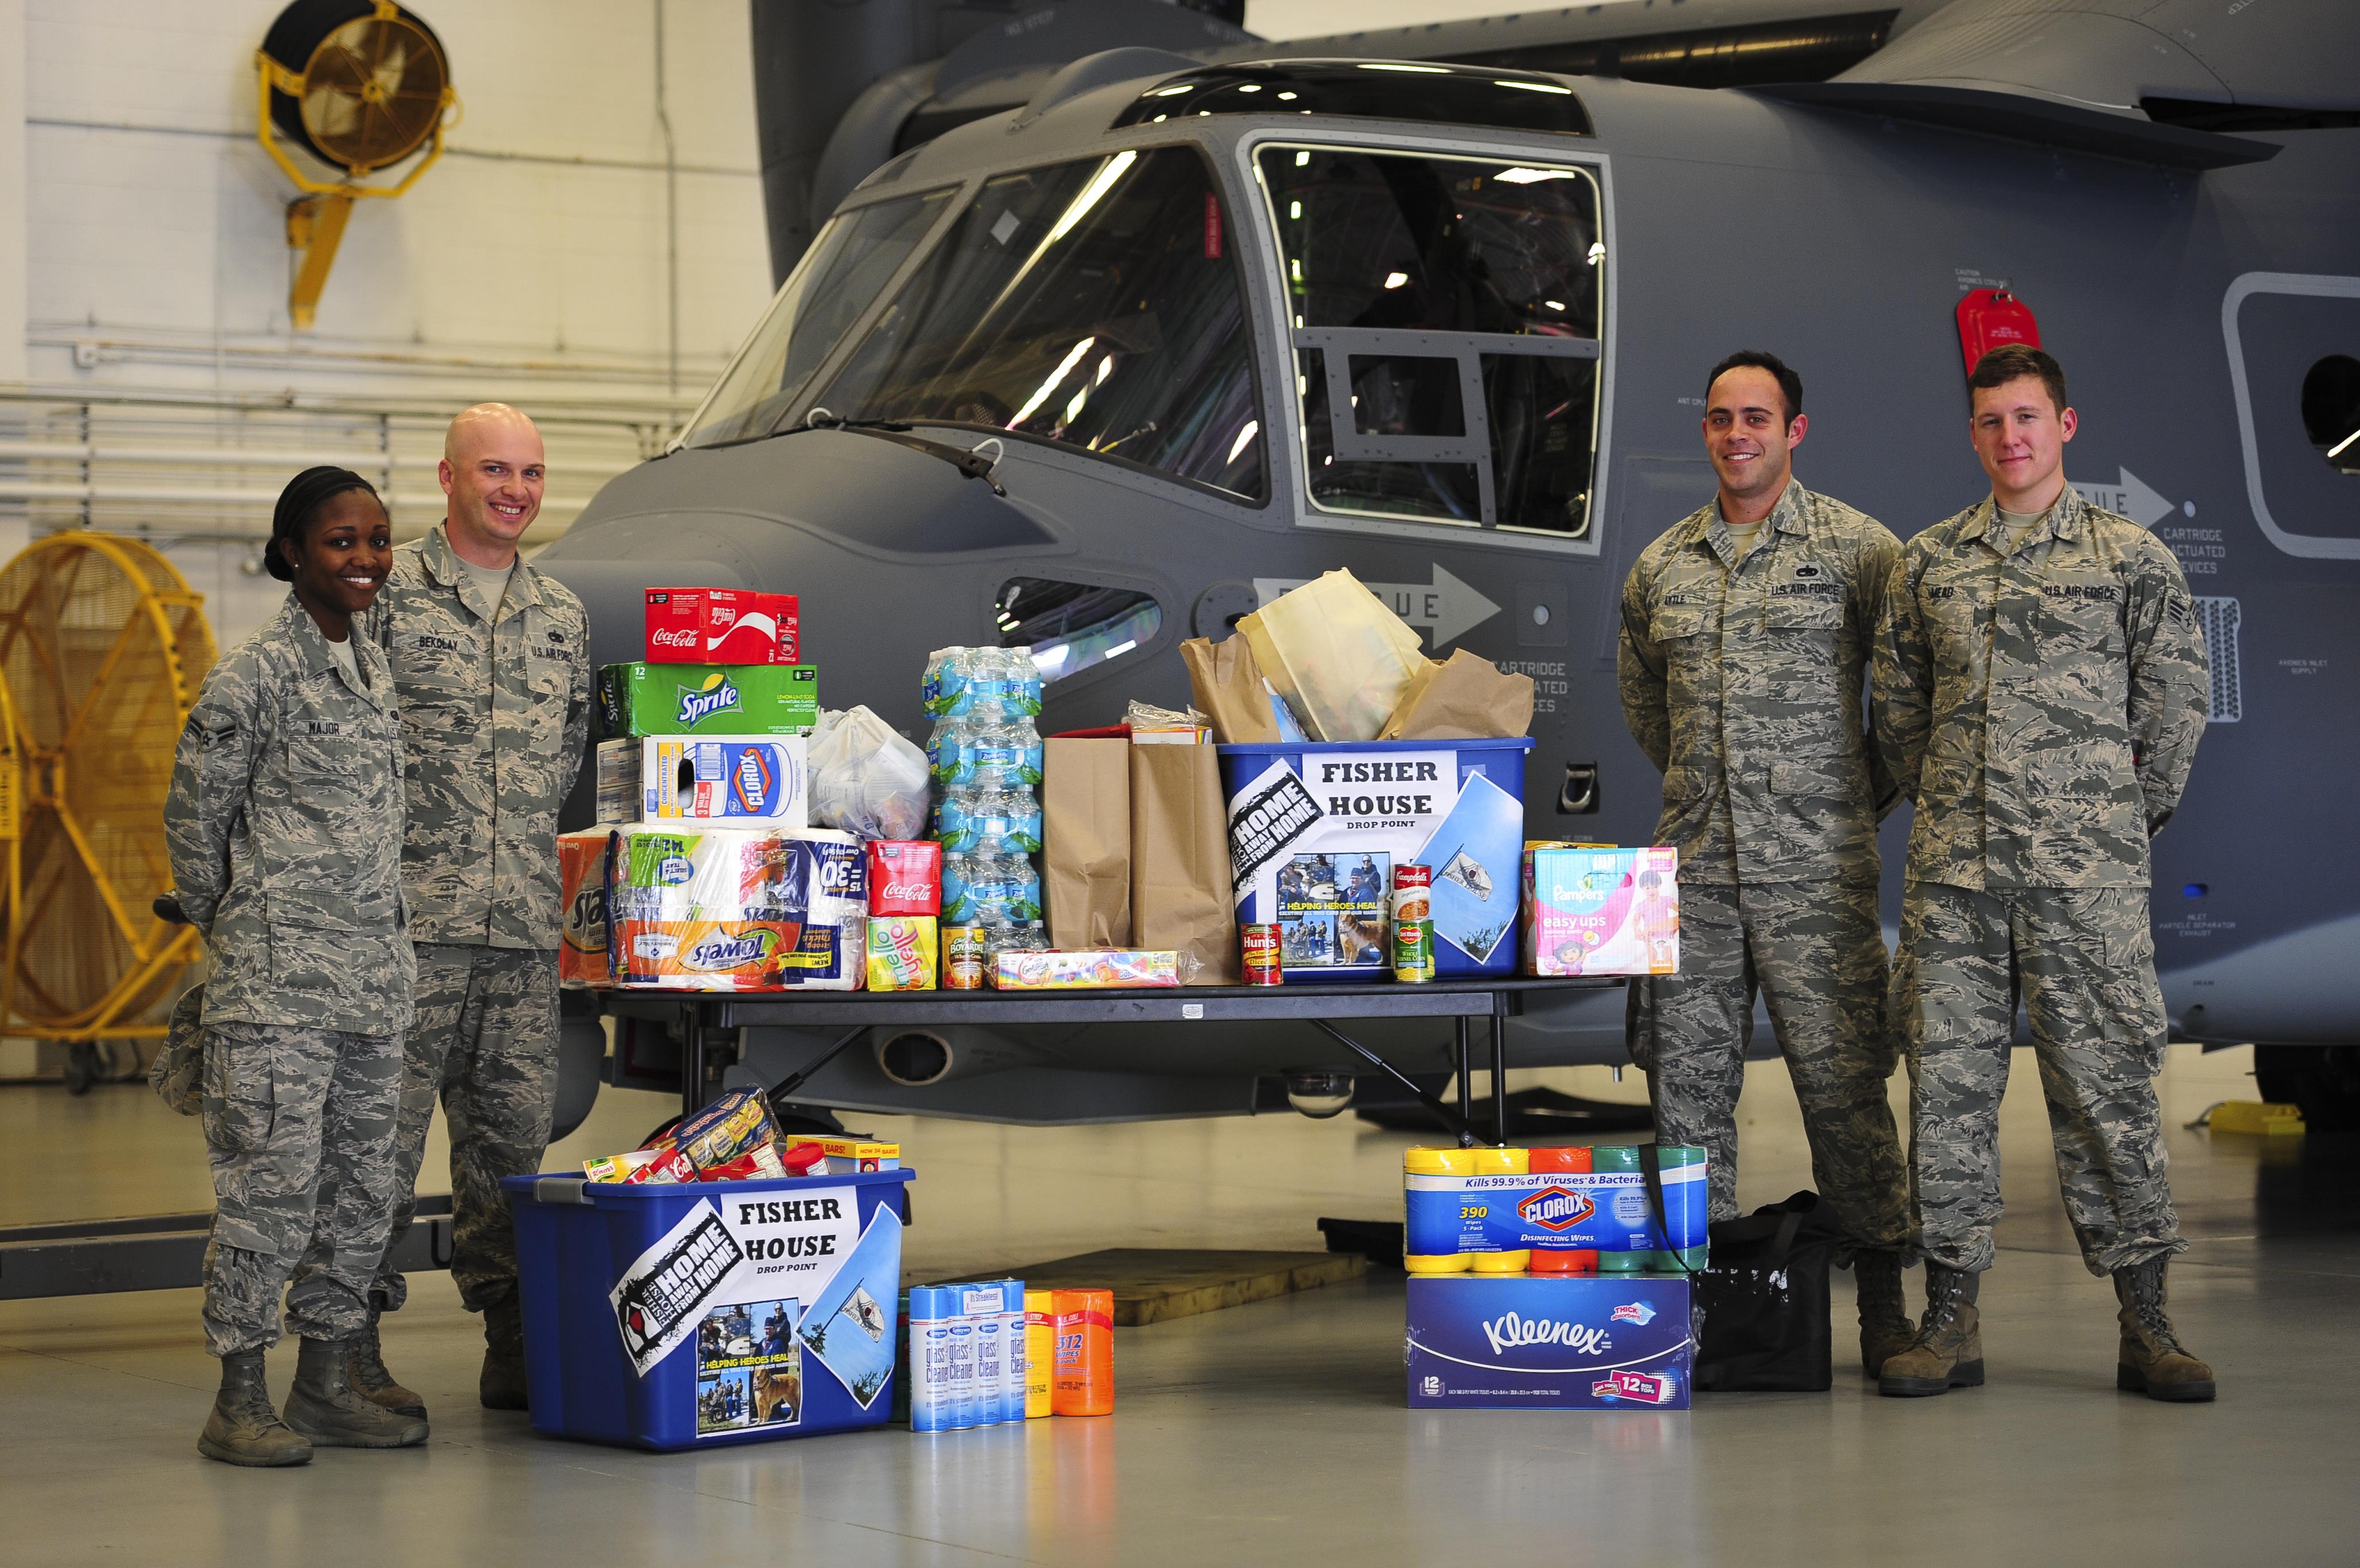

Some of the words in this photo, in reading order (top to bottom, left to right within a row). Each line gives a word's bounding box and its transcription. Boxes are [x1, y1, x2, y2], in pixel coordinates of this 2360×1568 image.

[2163, 528, 2222, 542] CARTRIDGE
[2179, 562, 2217, 574] EVICES
[1771, 585, 1787, 595] U.S.
[1791, 584, 1806, 594] AIR
[1809, 583, 1839, 595] FORCE
[2064, 586, 2081, 597] AIR
[2084, 586, 2116, 600] FORCE
[1665, 595, 1685, 606] LYTLE
[419, 636, 458, 652] BEKOLAY
[652, 628, 699, 647] Coca-Cola
[531, 646, 545, 657] U.S.
[545, 648, 557, 659] AIR
[635, 667, 645, 676] 12
[607, 680, 618, 722] Sprite
[679, 681, 737, 723] Sprite
[309, 722, 340, 735] MAJOR
[739, 754, 765, 806] CLOROX
[1322, 762, 1438, 783] FISHER
[697, 792, 705, 809] VALUE
[1329, 795, 1432, 816] HOUSE
[1234, 781, 1304, 846] HOME
[1268, 797, 1317, 842] HOME
[1347, 820, 1378, 830] DROP
[1381, 820, 1416, 828] POINT
[1244, 828, 1271, 854] AWAY
[1249, 837, 1277, 863] FROM
[820, 861, 852, 887] 30
[849, 881, 861, 892] 15
[883, 881, 934, 901] Coca-Cola
[1554, 884, 1604, 904] Pampers
[1287, 902, 1322, 910] HELPING
[1324, 902, 1355, 910] HEROES
[1543, 917, 1577, 929] easy
[1579, 916, 1606, 929] ups
[693, 934, 766, 963] Towels
[875, 931, 909, 986] mello
[891, 924, 923, 974] yello
[825, 1144, 845, 1154] BARS!
[592, 1166, 614, 1177] Knorr
[1465, 1175, 1490, 1187] Kills
[1491, 1176, 1525, 1187] 99.9%
[1527, 1175, 1541, 1186] of
[1589, 1175, 1597, 1185] &
[1598, 1174, 1645, 1185] Bacteria
[739, 1198, 841, 1225] FISHER
[1459, 1206, 1488, 1219] 390
[1525, 1191, 1586, 1224] CLOROX
[745, 1234, 837, 1260] HOUSE
[1520, 1234, 1570, 1242] DISINFECTING
[654, 1221, 726, 1296] HOME
[693, 1239, 738, 1289] HOME
[757, 1265, 784, 1275] DROP
[786, 1263, 817, 1272] POINT
[668, 1276, 696, 1305] AWAY
[674, 1285, 701, 1314] FROM
[642, 1288, 671, 1328] FISHER
[647, 1281, 678, 1321] HOUSE
[1615, 1306, 1637, 1314] THICK
[1056, 1334, 1083, 1350] 312
[1483, 1311, 1605, 1355] Kleenex
[926, 1347, 945, 1367] glass
[949, 1343, 969, 1364] glass
[978, 1340, 997, 1361] glass
[706, 1358, 738, 1370] HELPING
[740, 1355, 769, 1366] HEROES
[770, 1353, 789, 1363] HEAL
[1424, 1376, 1439, 1389] 12
[1622, 1377, 1640, 1392] 12
